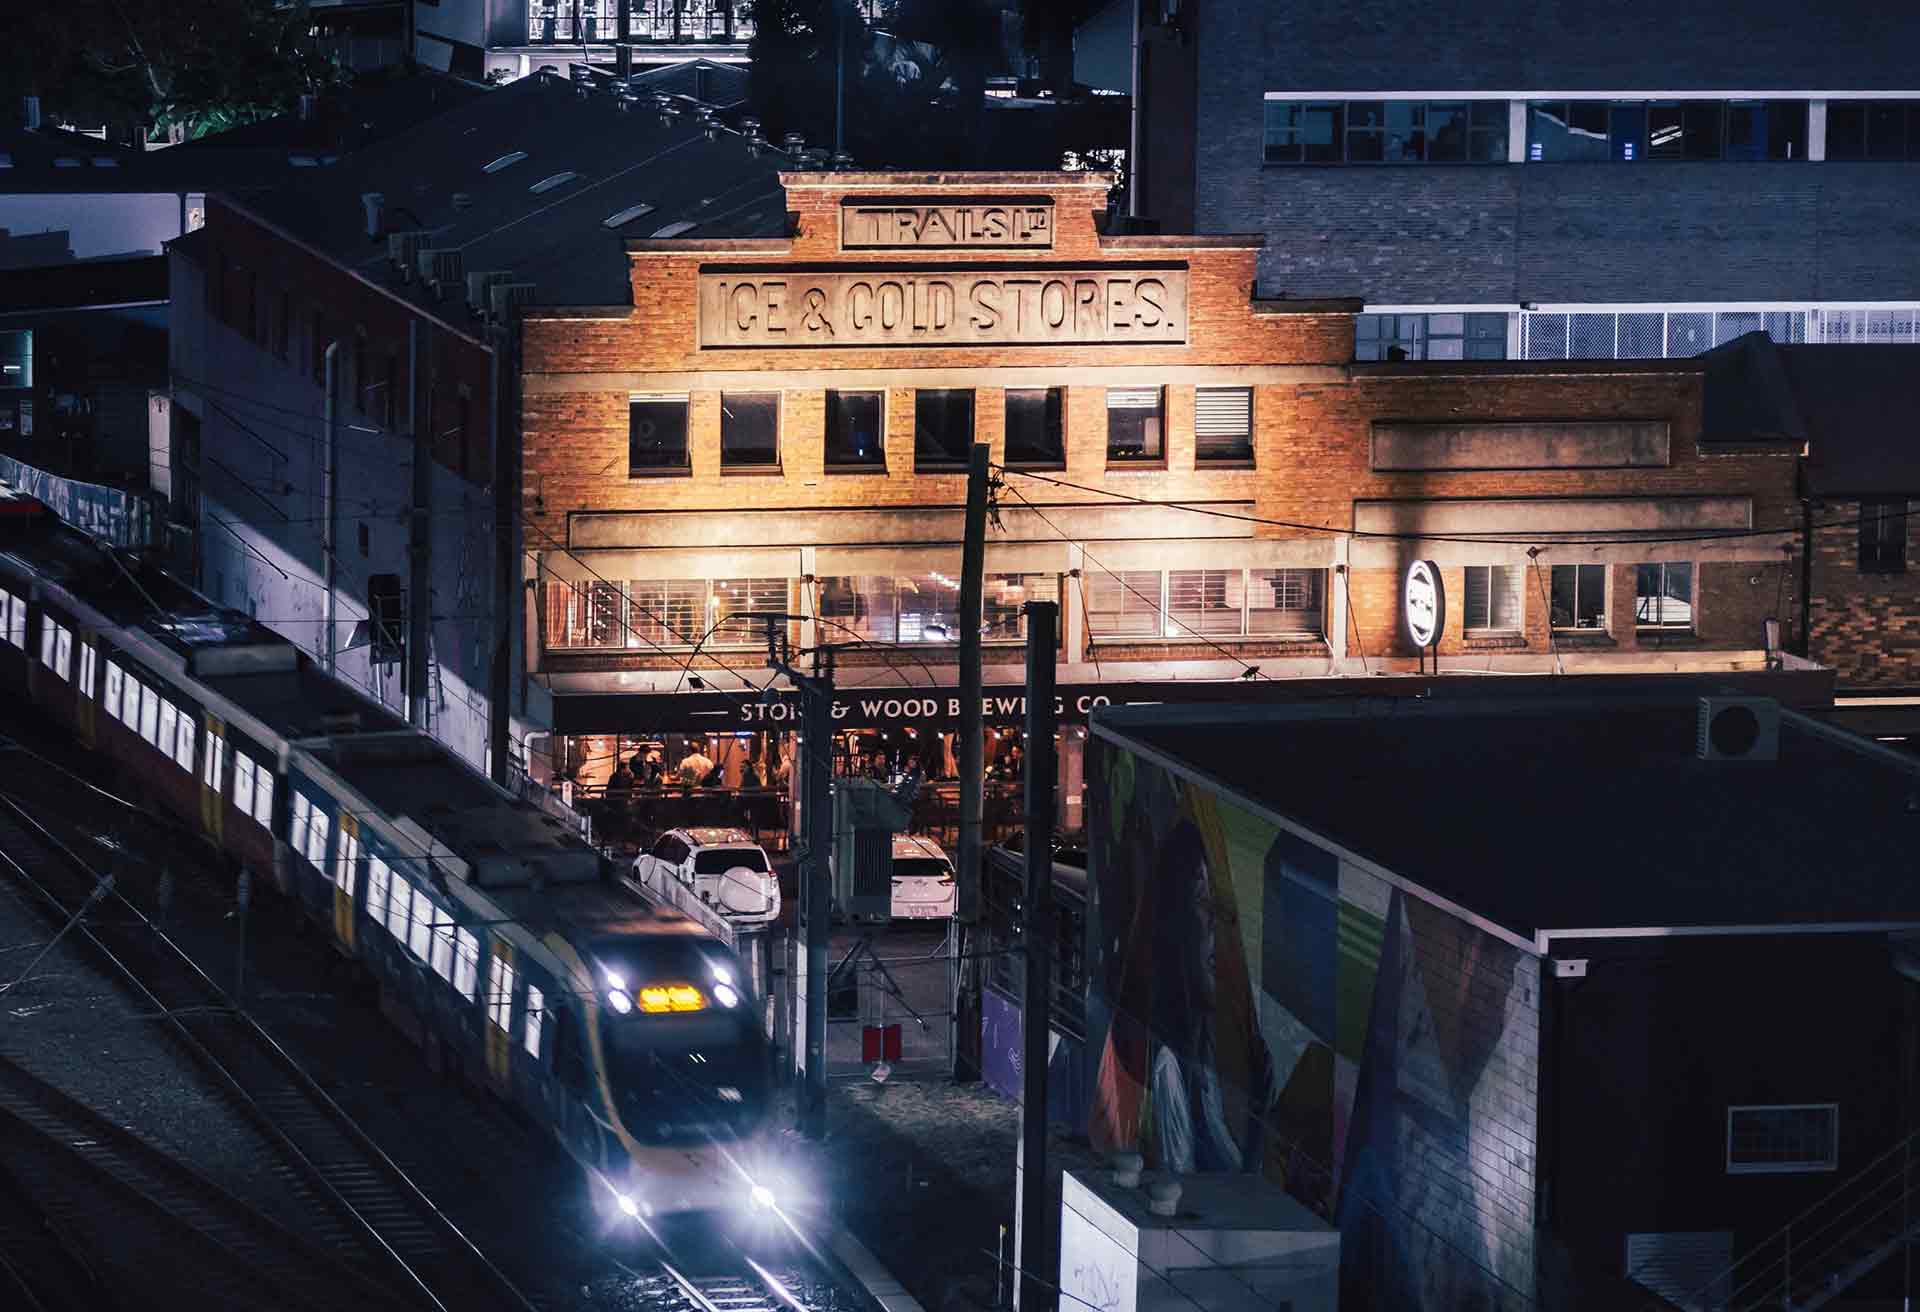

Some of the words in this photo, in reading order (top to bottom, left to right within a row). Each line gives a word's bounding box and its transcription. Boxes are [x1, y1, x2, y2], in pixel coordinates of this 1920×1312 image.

[856, 207, 1009, 241] TRAILS
[718, 282, 788, 336] ICE
[800, 287, 835, 337] &
[846, 281, 956, 335] COLD
[741, 702, 814, 721] STO
[831, 701, 850, 719] &
[861, 699, 938, 717] WOOD
[948, 697, 1064, 716] BEWIG
